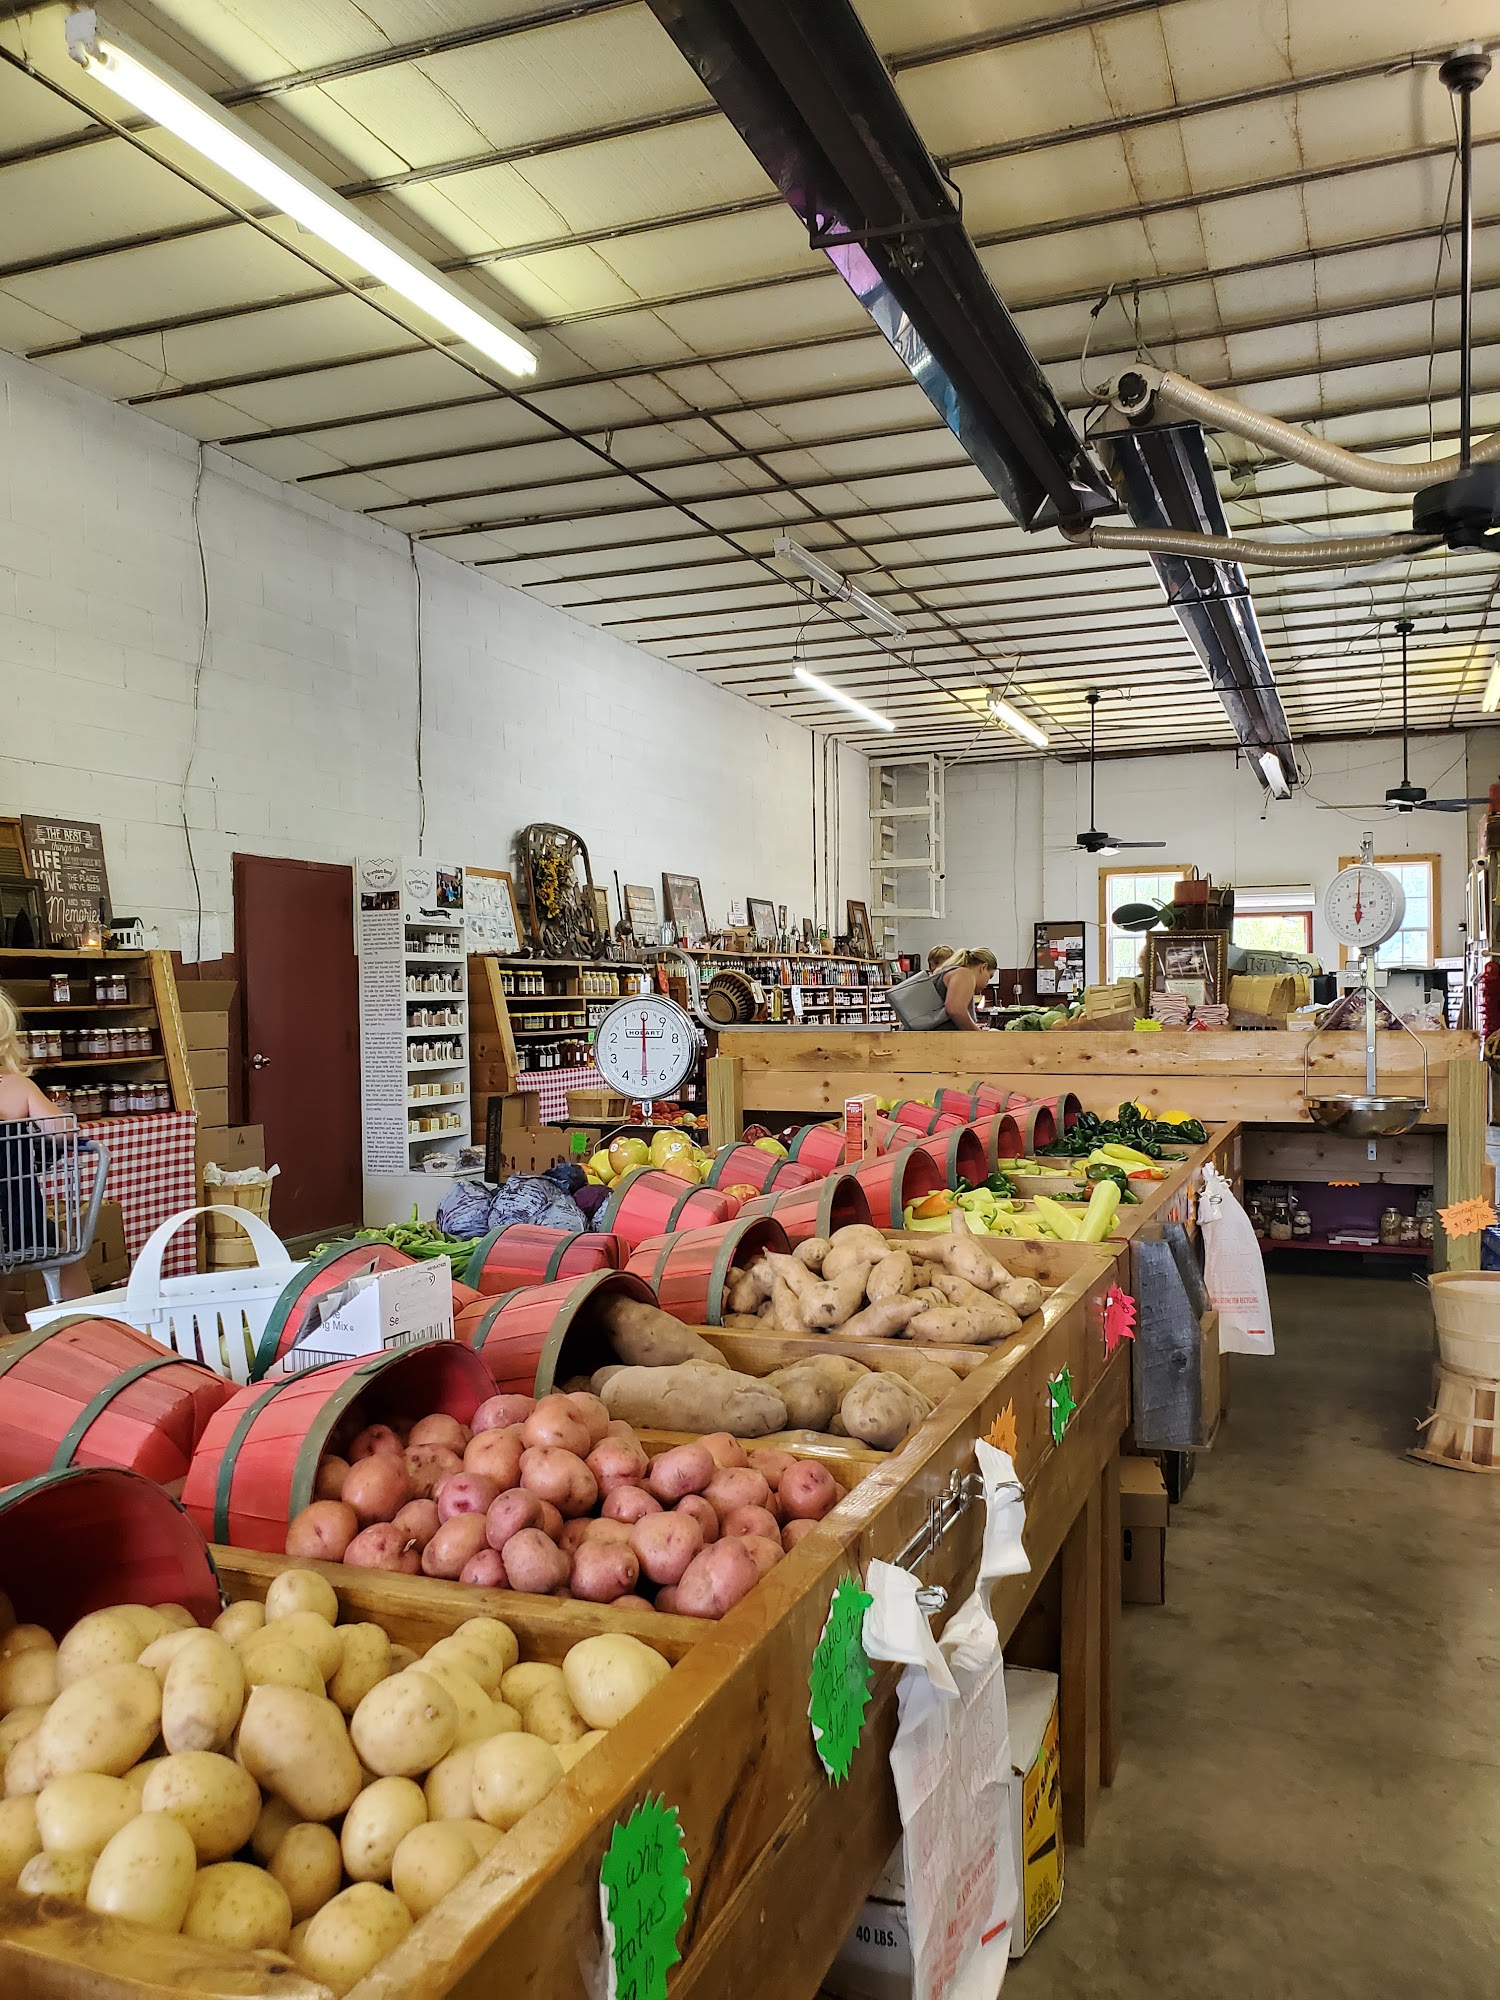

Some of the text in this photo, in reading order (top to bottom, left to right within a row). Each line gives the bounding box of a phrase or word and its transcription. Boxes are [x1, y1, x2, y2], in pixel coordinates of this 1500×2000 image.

[46, 828, 82, 842] THE BEST
[52, 842, 80, 856] things in
[31, 849, 62, 870] LIFE
[640, 1011, 648, 1021] 0
[624, 1017, 627, 1026] 1
[659, 1017, 666, 1027] 9
[610, 1033, 618, 1043] 2
[672, 1034, 678, 1043] 8
[610, 1054, 617, 1064] 3
[673, 1055, 680, 1065] 7
[622, 1071, 629, 1080] 4
[659, 1070, 666, 1080] 6
[641, 1076, 648, 1086] 5
[332, 1320, 349, 1331] Mix
[856, 1926, 897, 1947] 40 LBS.
